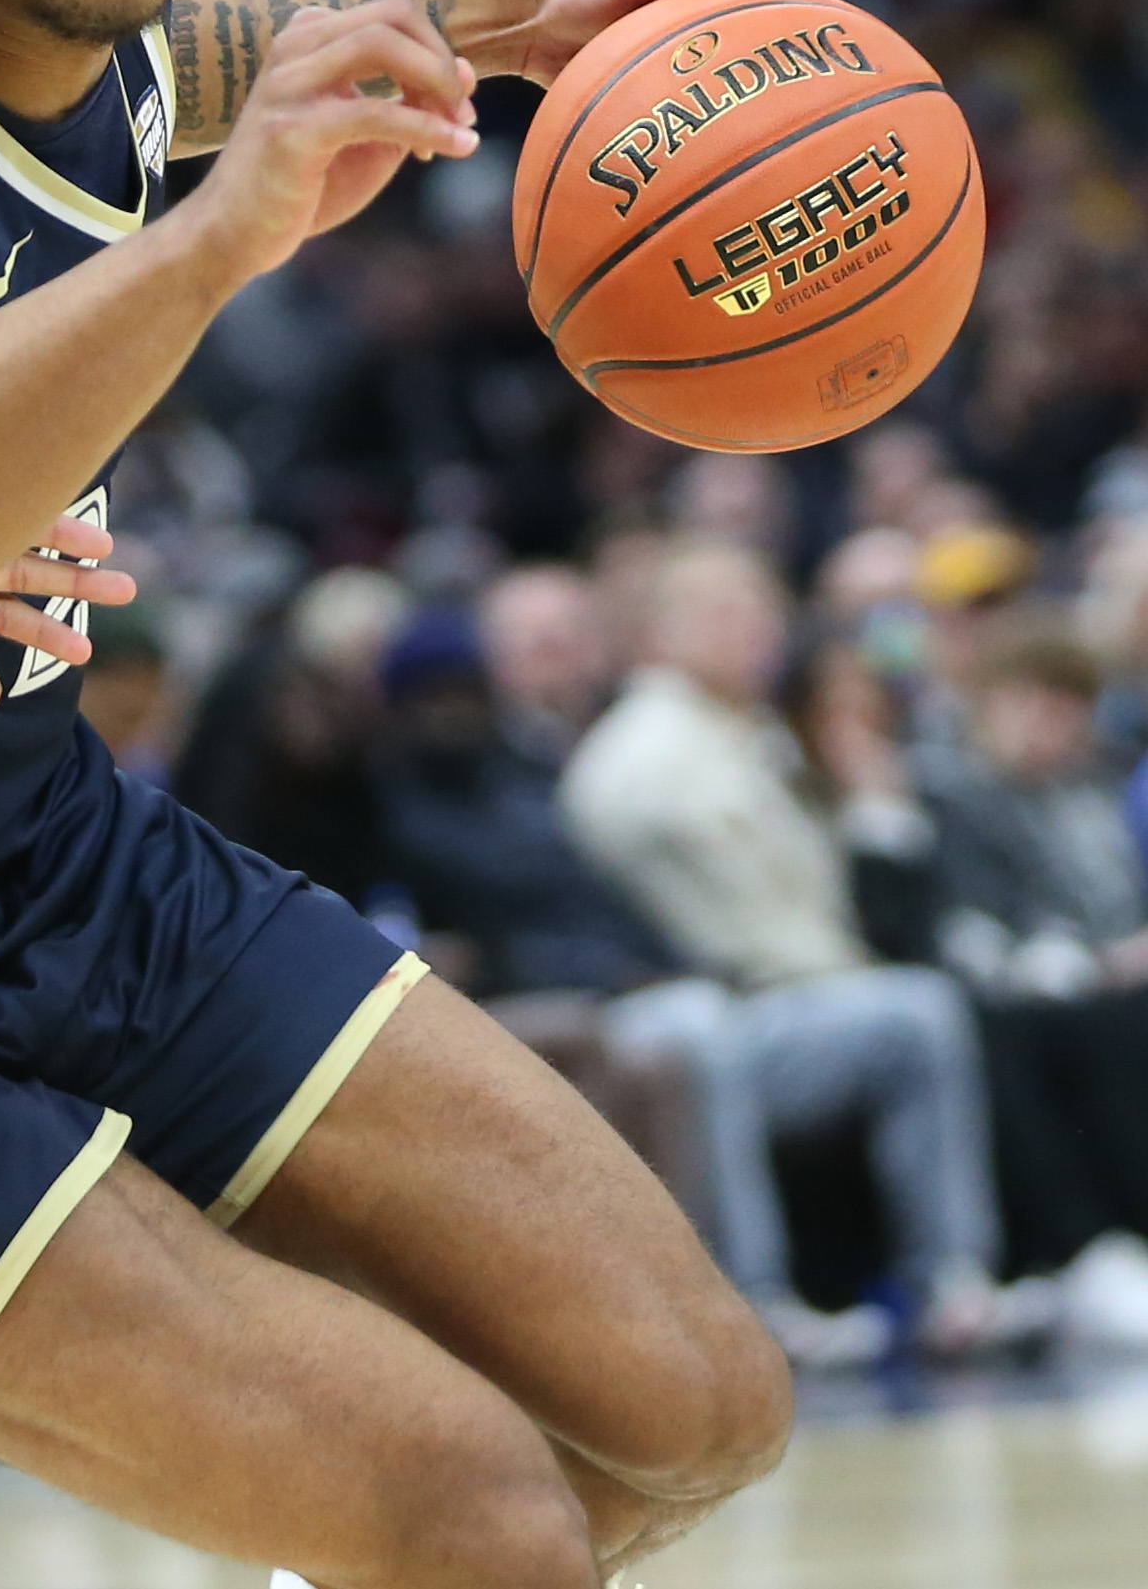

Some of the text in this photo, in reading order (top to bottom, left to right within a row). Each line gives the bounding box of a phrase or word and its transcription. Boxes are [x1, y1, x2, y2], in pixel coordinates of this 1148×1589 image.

[587, 22, 877, 218] SPALDING
[673, 131, 909, 299] LEGACY
[717, 189, 911, 312] TF 1000
[774, 240, 894, 315] OFFICIAL GAME BALL
